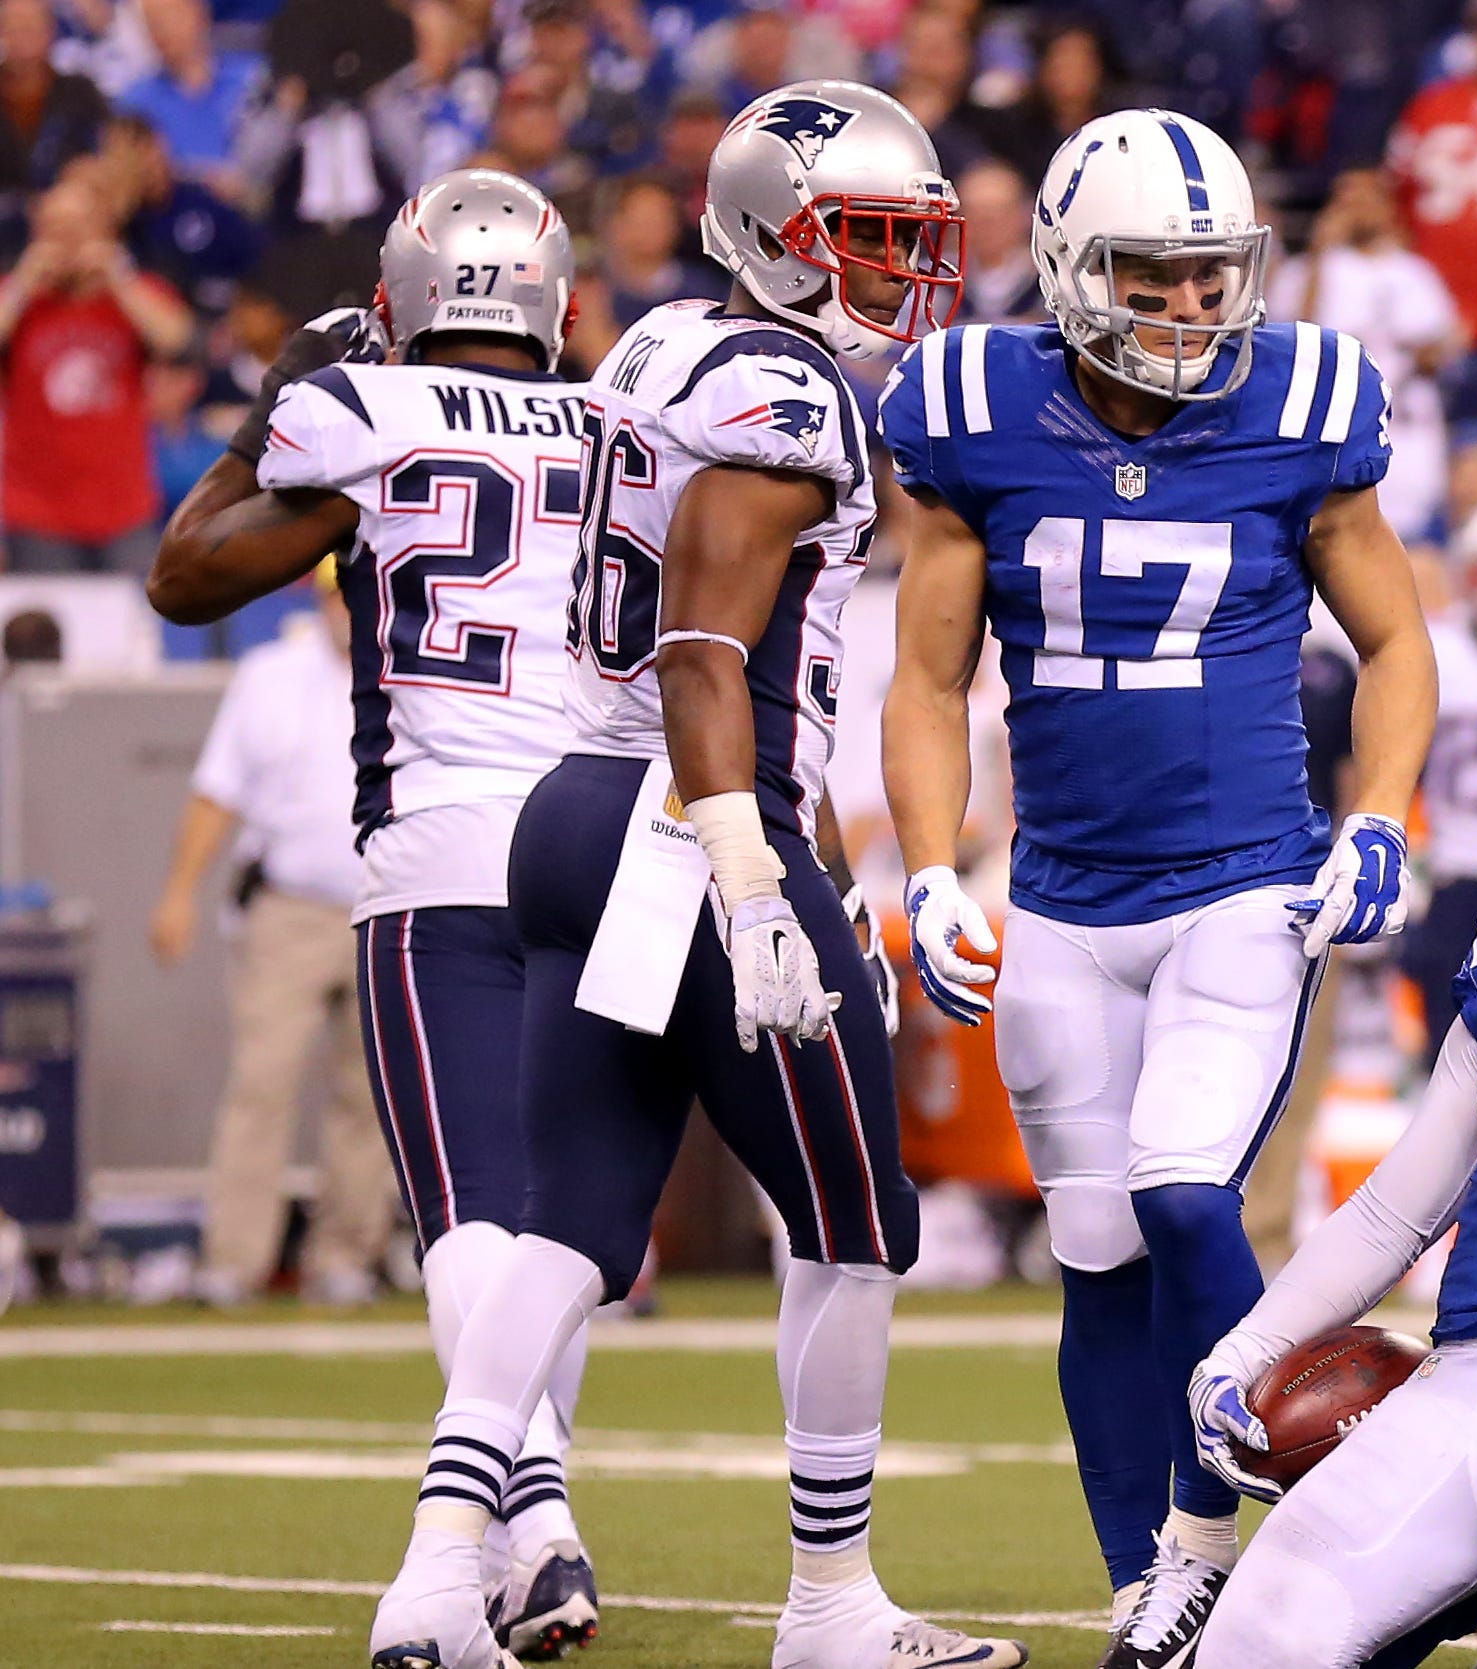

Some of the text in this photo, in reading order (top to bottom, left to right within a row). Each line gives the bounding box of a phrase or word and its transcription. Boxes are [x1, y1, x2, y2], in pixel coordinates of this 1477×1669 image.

[456, 264, 500, 296] 27
[446, 306, 514, 323] PATRIOTS
[1022, 516, 1234, 691] 17
[650, 819, 698, 844] Wilson
[1281, 1366, 1316, 1397] LEAGUE
